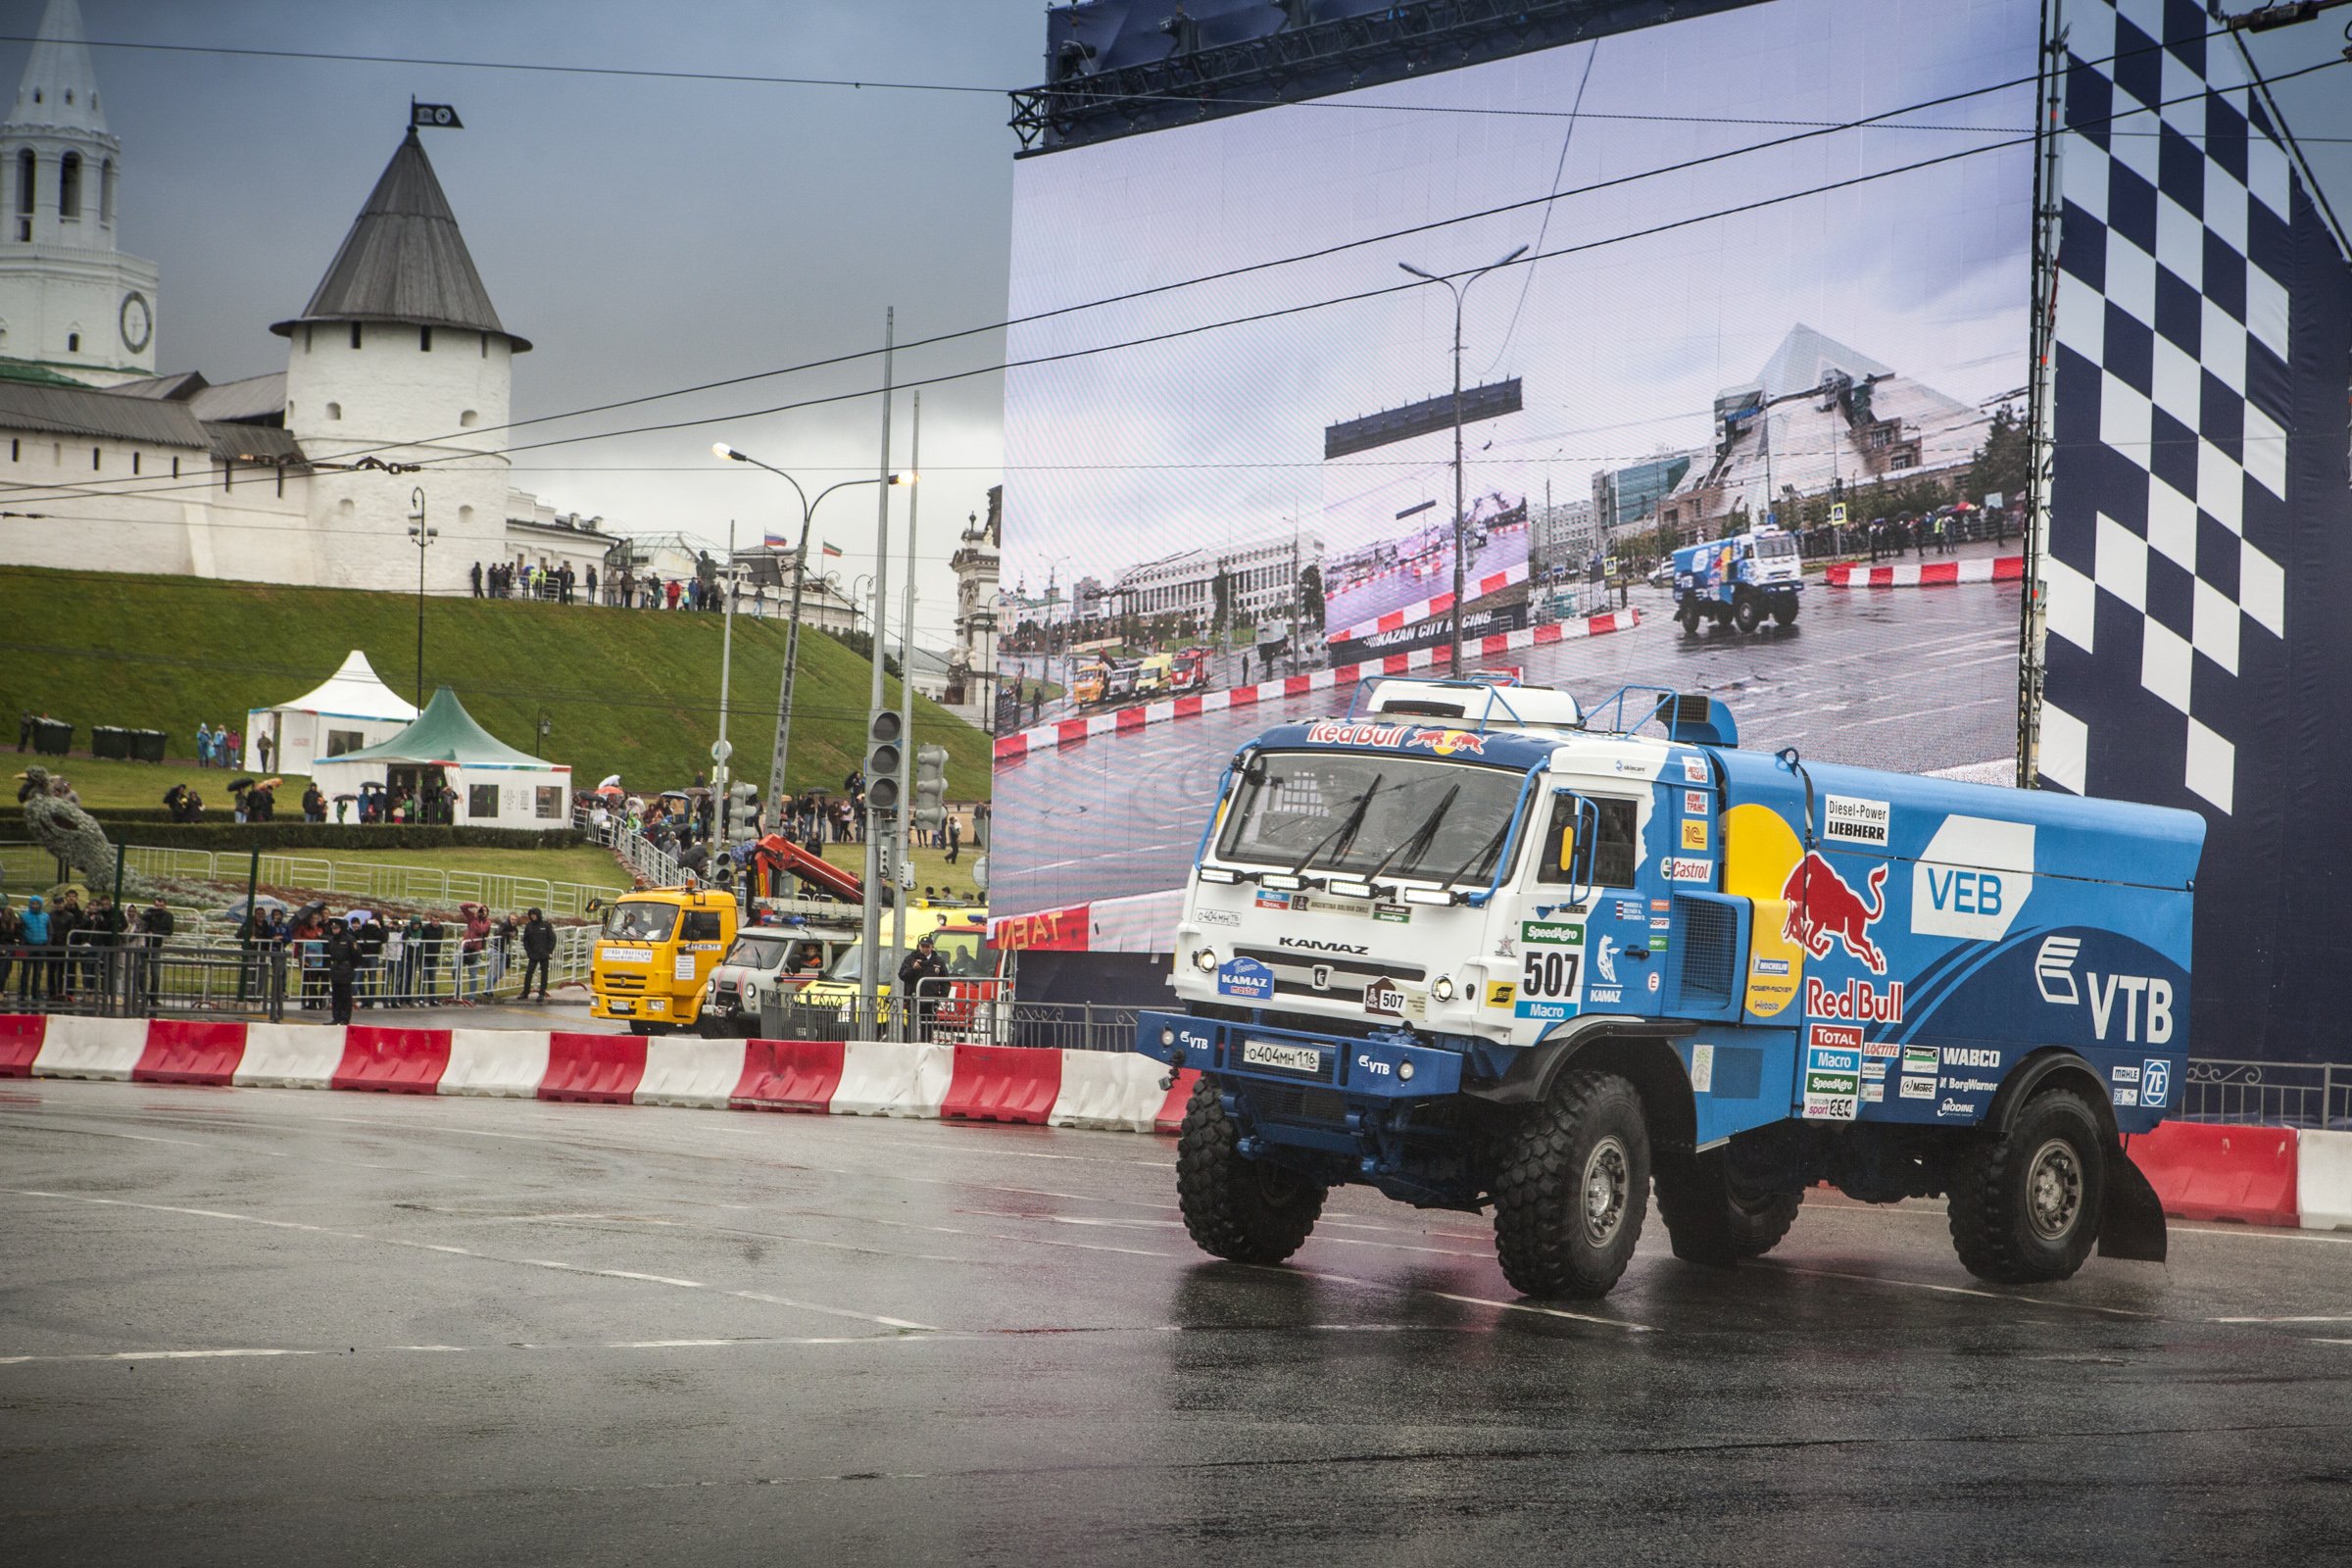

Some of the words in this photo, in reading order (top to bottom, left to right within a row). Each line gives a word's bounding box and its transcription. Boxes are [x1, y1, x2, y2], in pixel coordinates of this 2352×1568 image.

[1377, 626, 1415, 647] KAZAN
[1418, 619, 1443, 638] CITY
[1446, 610, 1493, 632] RCING
[1306, 723, 1355, 743] Red
[1354, 725, 1409, 747] Bull
[1688, 793, 1700, 803] КОМ
[1687, 802, 1706, 812] ТРАНС
[1829, 800, 1886, 820] Diesel-Power
[1828, 820, 1886, 841] LIEBHERR
[1673, 861, 1709, 879] Castrol
[1264, 892, 1283, 901] Macro
[1927, 867, 2003, 916] VEB
[1310, 901, 1337, 910] ARGENTINA
[1337, 904, 1355, 912] BOLIVIA
[1355, 906, 1369, 914] CHILE
[1527, 925, 1578, 941] SpeedAgro
[1279, 936, 1370, 956] KAMAZ
[1760, 961, 1788, 971] MICHELIN
[1221, 973, 1268, 988] KAMAZ
[1523, 951, 1580, 998] 507
[1230, 986, 1260, 996] master
[1590, 990, 1621, 1004] KAMAZ
[1383, 993, 1404, 1008] 507
[1807, 976, 1854, 1020] Red
[1858, 981, 1903, 1022] Bull
[1530, 1004, 1564, 1018] Macro
[2086, 971, 2174, 1045] VTB
[1189, 1037, 1208, 1050] VTB
[1817, 1028, 1856, 1046] TOTAL
[1297, 1051, 1317, 1064] 116
[1865, 1044, 1899, 1056] LOCTITE
[1818, 1052, 1851, 1068] Macro
[1943, 1048, 2000, 1068] WABCO
[1369, 1061, 1390, 1075] VTB
[2114, 1069, 2138, 1079] MAHLE
[1812, 1077, 1853, 1092] SpeedAgro
[1949, 1077, 1998, 1093] BorgWarner
[2146, 1071, 2166, 1096] ZF
[1809, 1105, 1829, 1115] sport
[1941, 1102, 1975, 1113] MODINE
